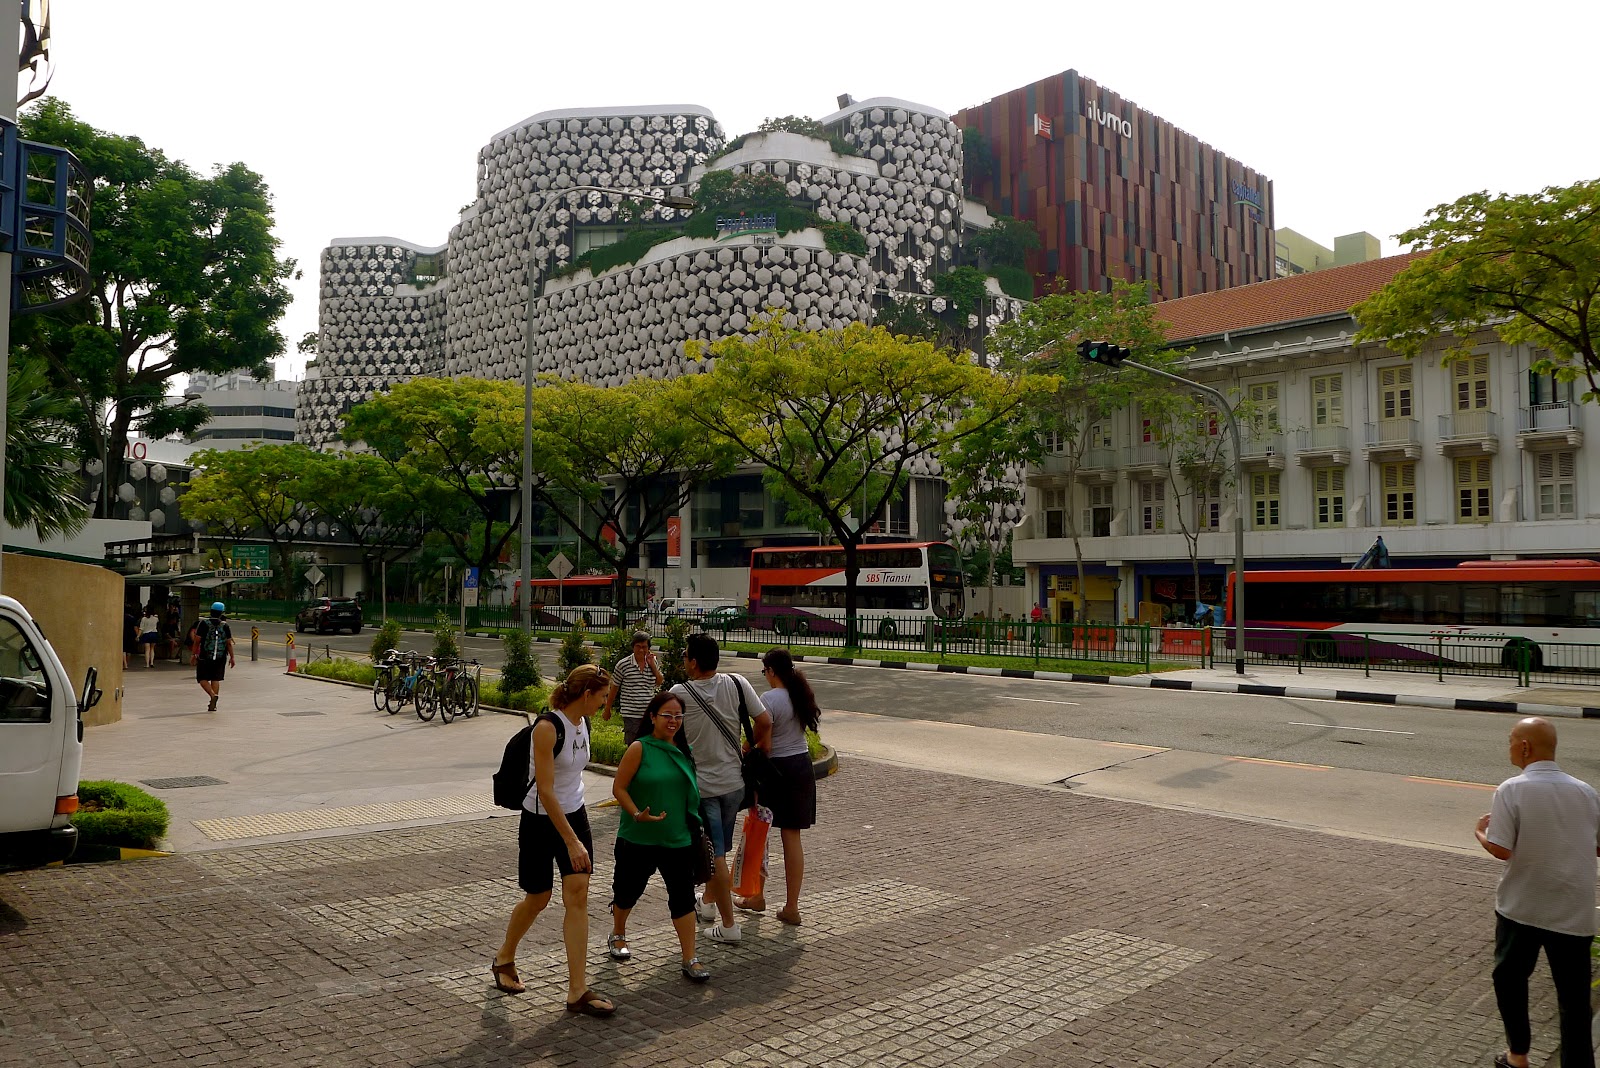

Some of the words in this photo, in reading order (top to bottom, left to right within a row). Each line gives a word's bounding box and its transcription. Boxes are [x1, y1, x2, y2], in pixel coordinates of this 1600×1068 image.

[1087, 99, 1132, 139] iluma
[751, 234, 776, 245] Trust
[465, 568, 472, 581] P
[865, 573, 880, 583] SBS
[880, 571, 912, 584] Transit
